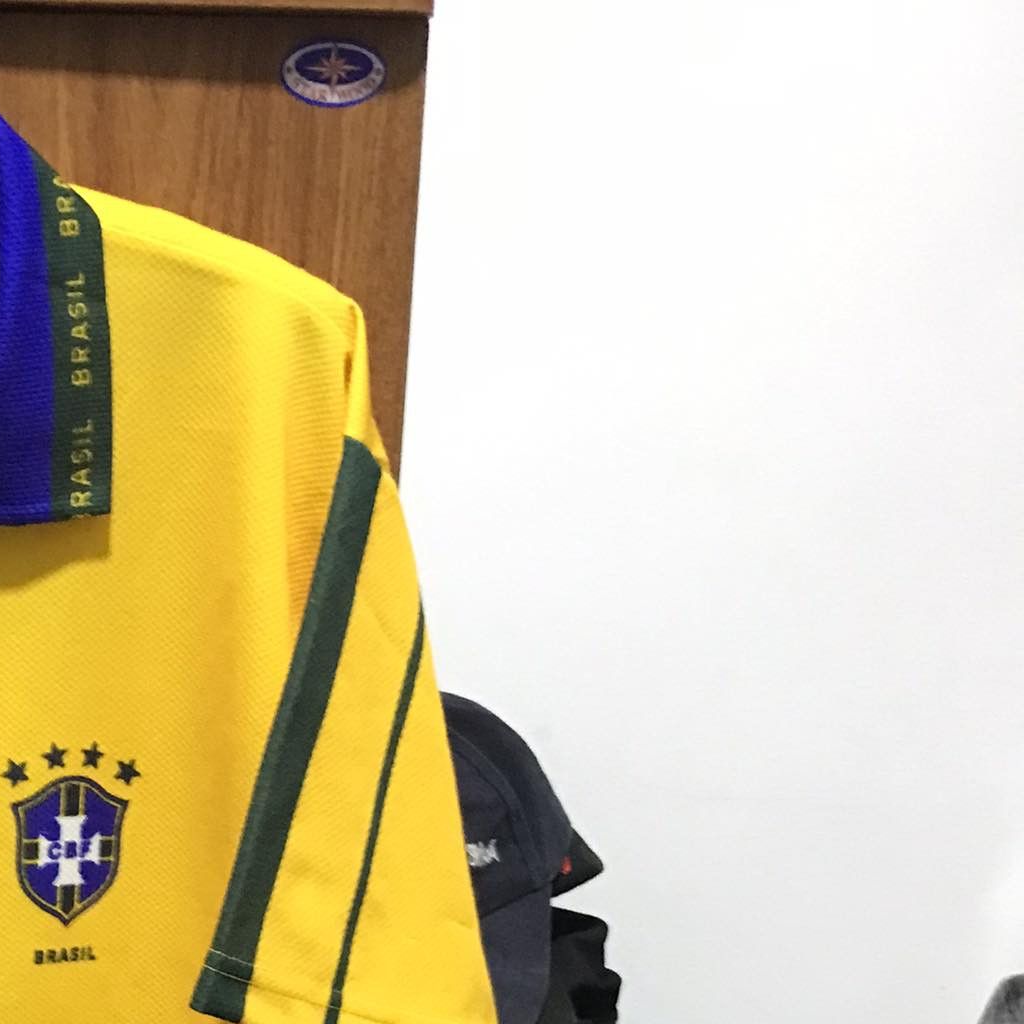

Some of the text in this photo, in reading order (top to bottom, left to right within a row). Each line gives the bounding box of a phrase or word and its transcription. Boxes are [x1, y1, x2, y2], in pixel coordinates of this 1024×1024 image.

[65, 272, 93, 386] BRASIL
[69, 418, 96, 518] RASIL
[34, 946, 96, 964] BRASIL
